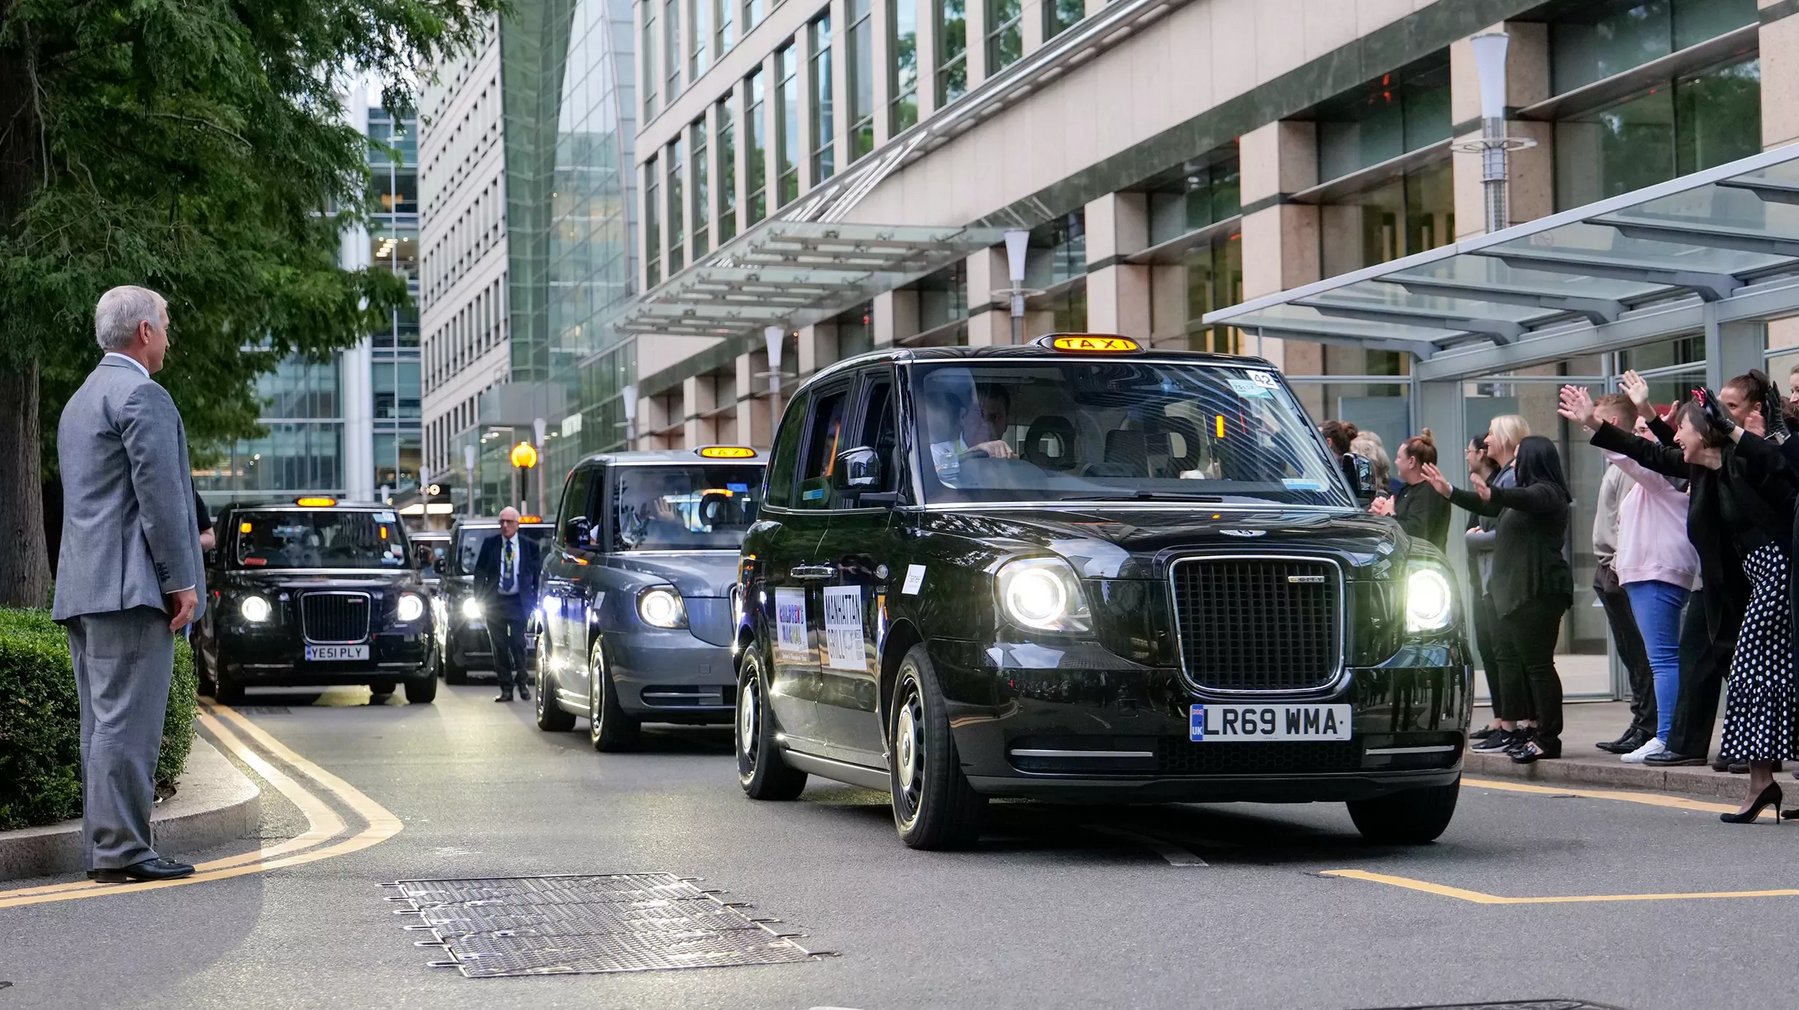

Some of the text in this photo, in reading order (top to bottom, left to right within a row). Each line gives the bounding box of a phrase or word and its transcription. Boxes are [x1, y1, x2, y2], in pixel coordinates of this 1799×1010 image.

[1061, 340, 1130, 349] TAXI
[1254, 374, 1275, 386] 42
[312, 647, 362, 658] YE51 PLY
[1203, 708, 1338, 735] LR69 WMA
[1192, 726, 1203, 735] UK
